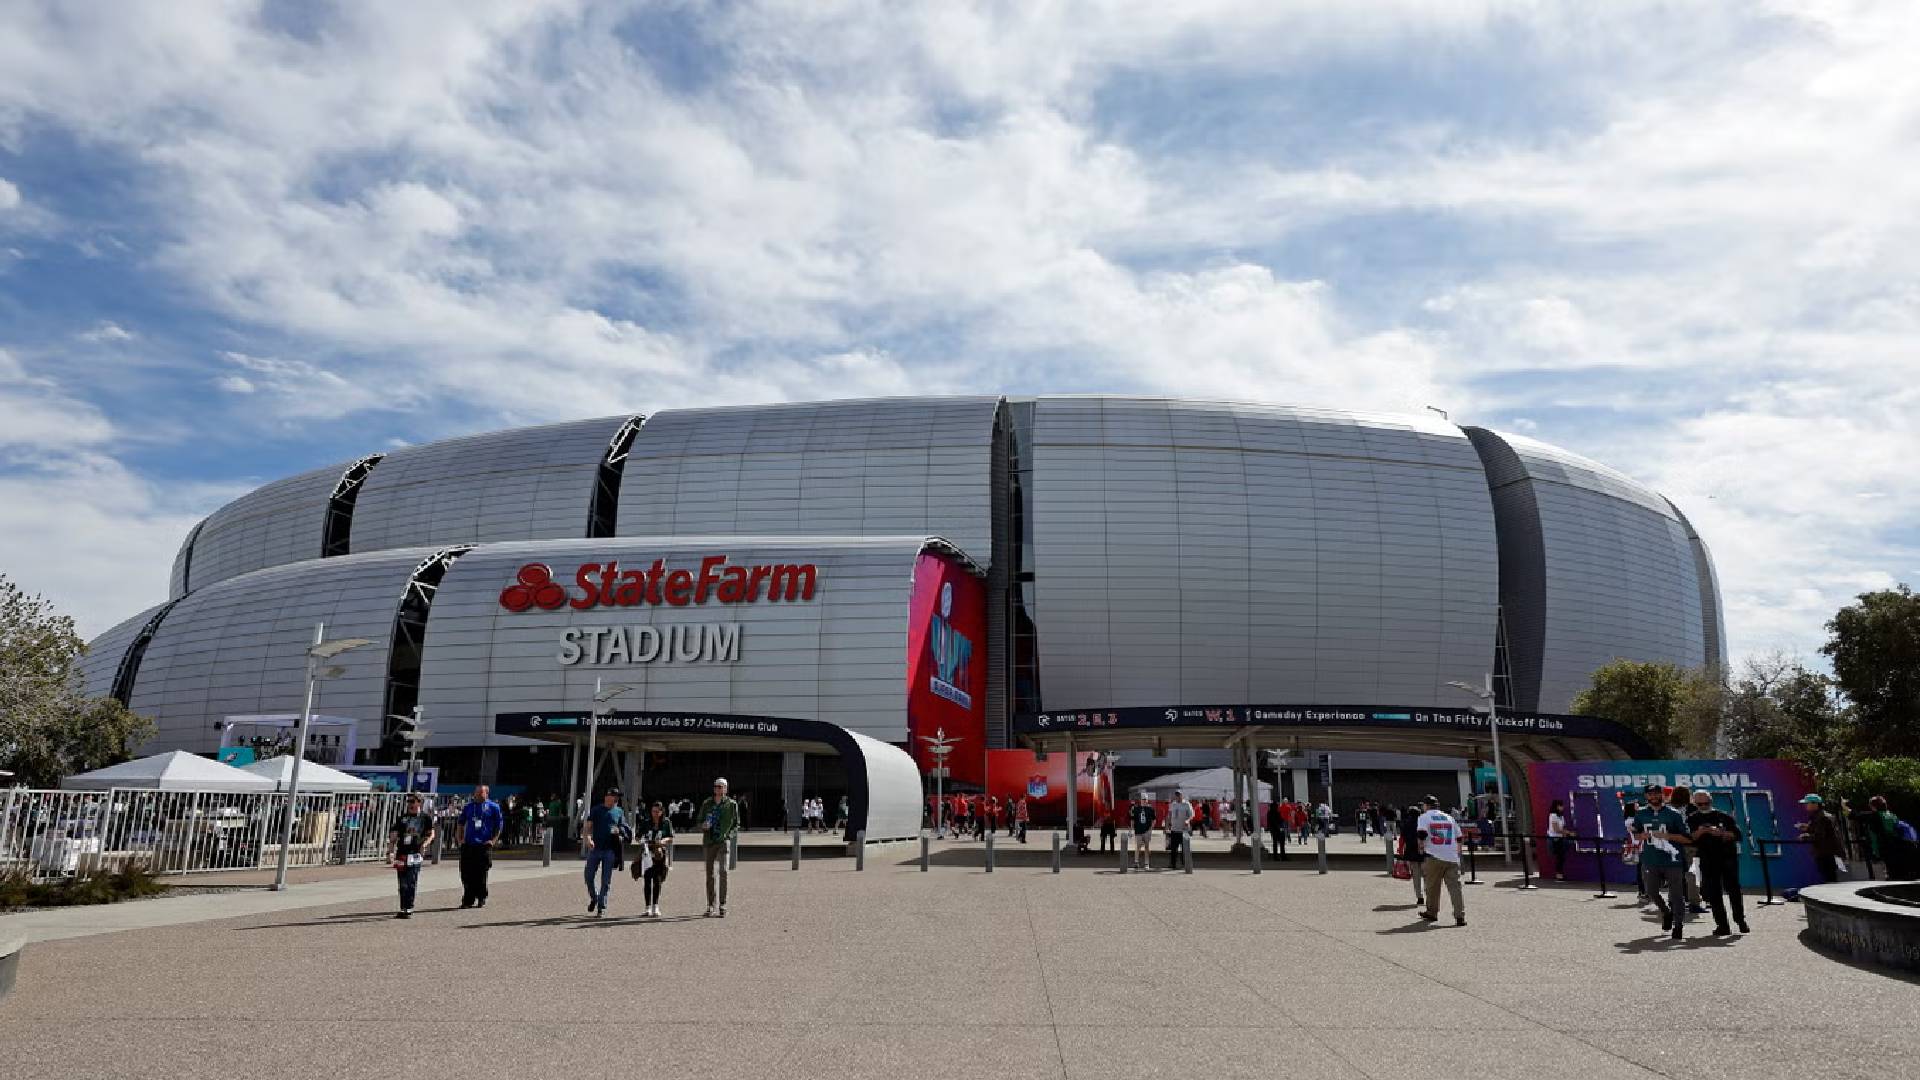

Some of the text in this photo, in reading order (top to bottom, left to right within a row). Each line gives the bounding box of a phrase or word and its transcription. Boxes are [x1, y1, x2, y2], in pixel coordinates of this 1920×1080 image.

[559, 623, 741, 665] STADIUM
[1255, 710, 1365, 721] Gameday Experience
[1415, 714, 1429, 722] On
[1433, 714, 1451, 723] The
[1454, 714, 1482, 726] Fifty
[1538, 718, 1563, 730] Club
[581, 717, 630, 726] Tochdown
[633, 717, 653, 726] Club
[660, 717, 681, 727] Club
[703, 718, 754, 730] Champions
[757, 721, 778, 732] Club
[1577, 773, 1758, 788] SUPER BOWL
[1429, 822, 1453, 846] 57
